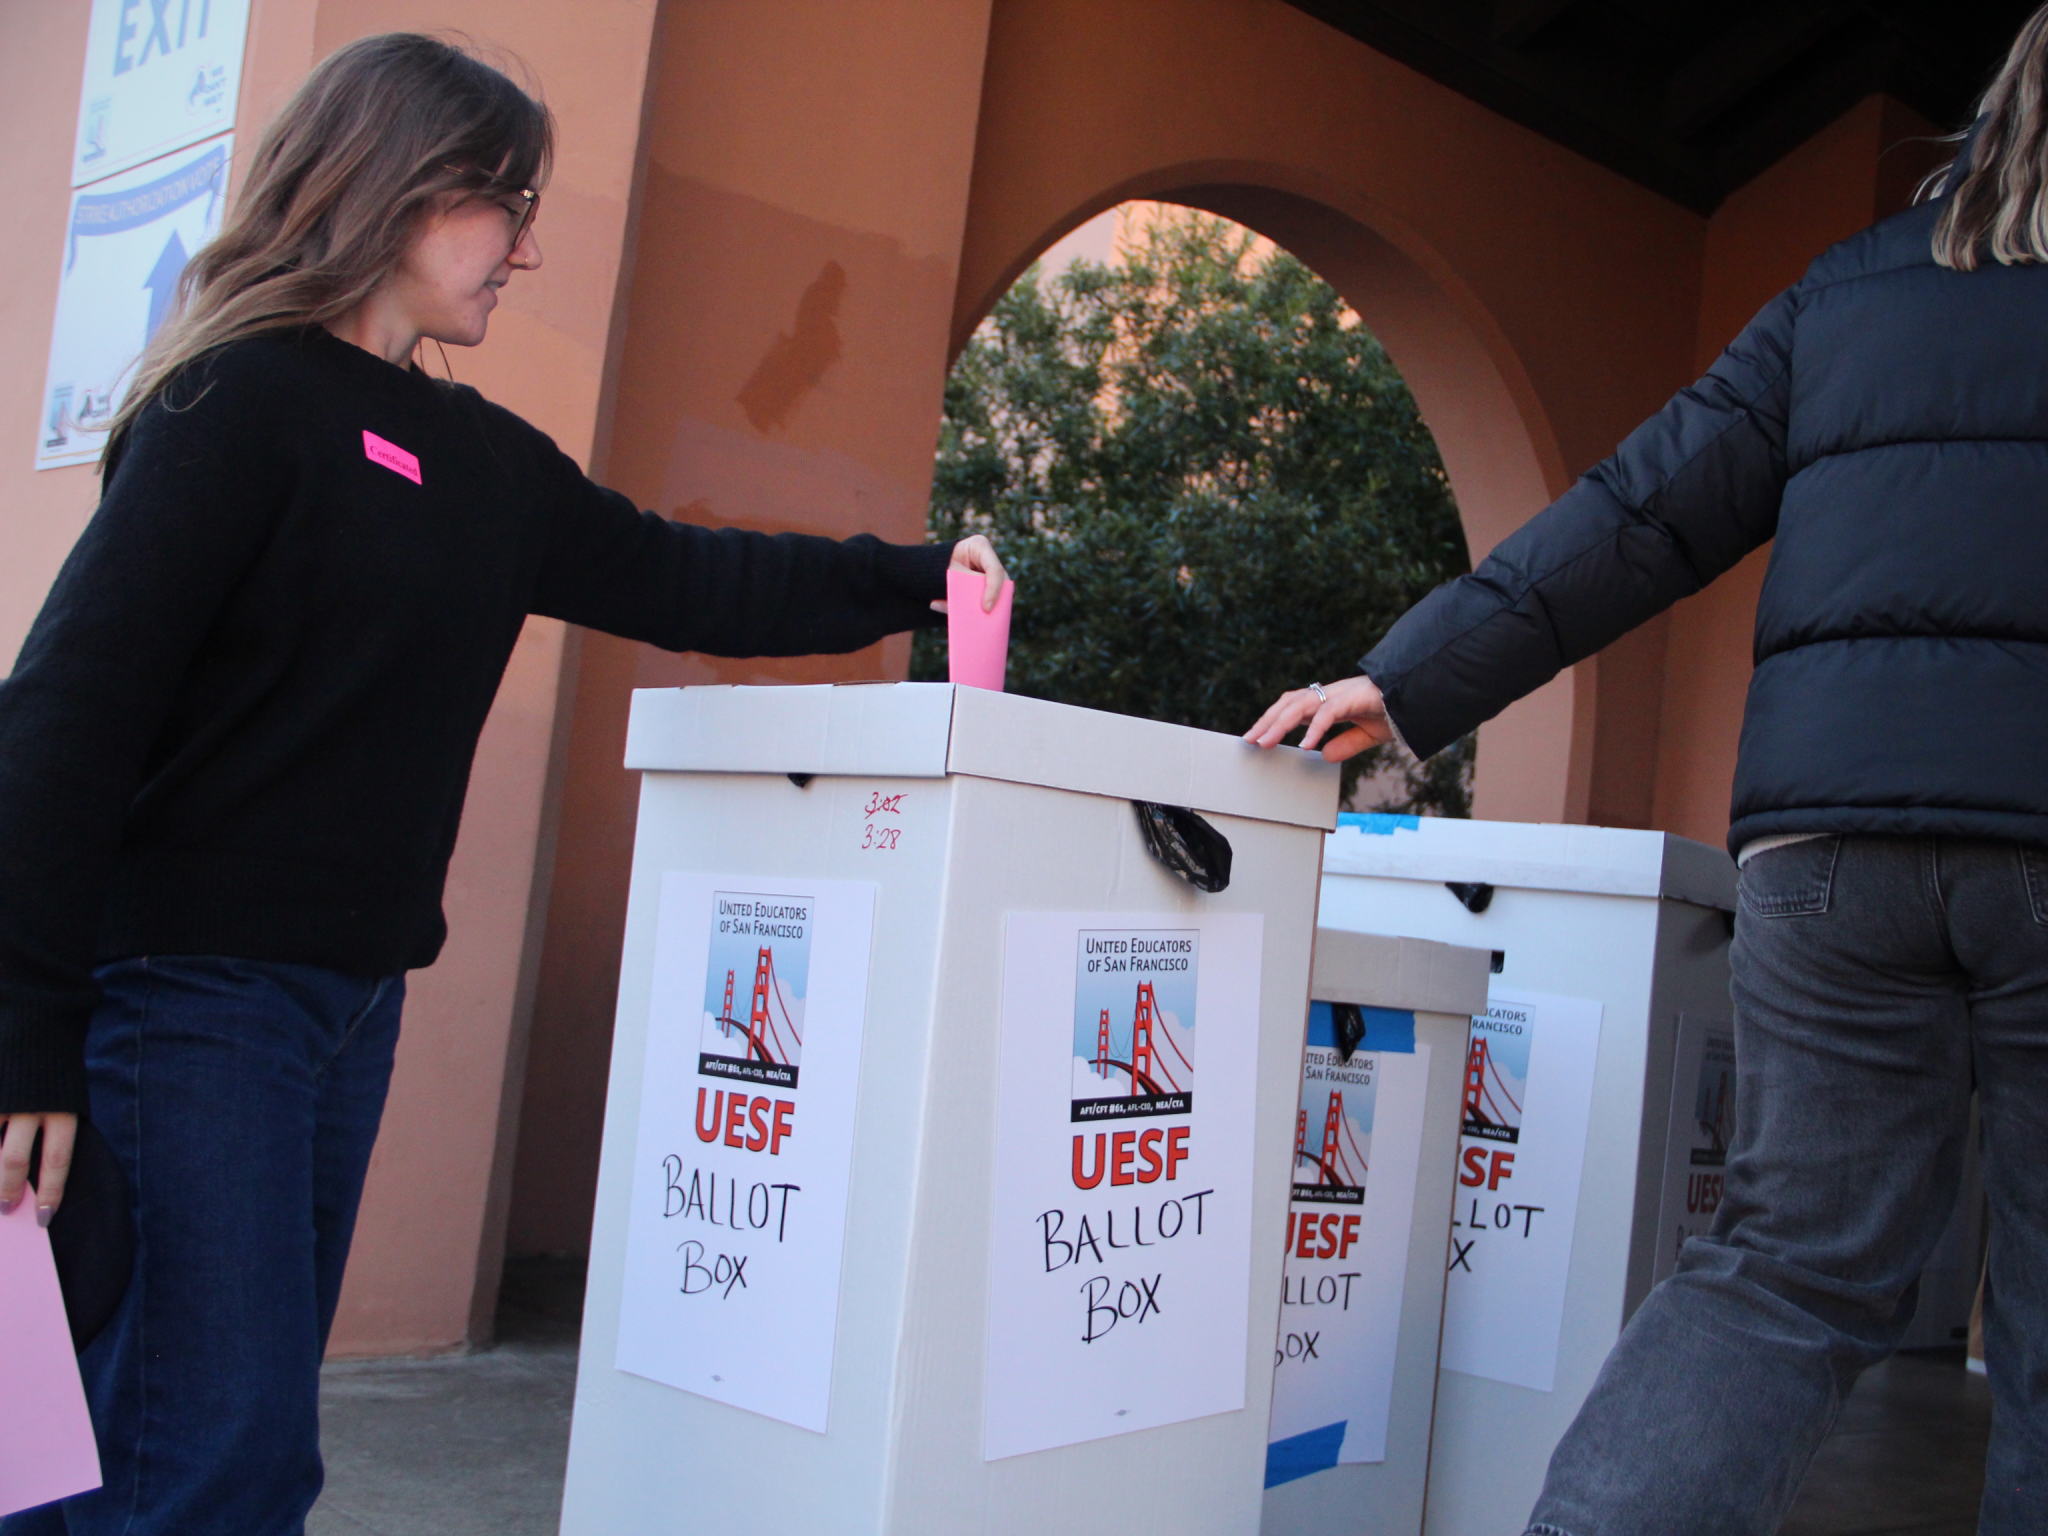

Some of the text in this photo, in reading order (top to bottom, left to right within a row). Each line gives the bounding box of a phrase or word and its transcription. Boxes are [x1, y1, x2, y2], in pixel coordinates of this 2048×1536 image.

[862, 824, 901, 849] 3:28
[719, 899, 807, 921] UNITED EDUCATORS
[719, 918, 804, 939] OF SAN FRANCISCO
[1086, 937, 1192, 954] UNITED EDUCATORS
[1087, 956, 1189, 973] OF SAN FRANCISCO
[1485, 1007, 1527, 1022] CATORS
[1472, 1019, 1523, 1035] RANCISCO
[705, 1059, 727, 1072] AFT/CFT
[765, 1068, 792, 1082] NEA/CTA
[1305, 1052, 1324, 1065] ITED
[1305, 1065, 1370, 1085] SAN FRANCISCO
[1080, 1102, 1108, 1116] AFT/CFT
[1109, 1103, 1127, 1114] #61,
[1155, 1097, 1184, 1110] NEA/CTA
[695, 1087, 795, 1155] UESF
[1071, 1126, 1191, 1190] UESF
[1460, 1145, 1515, 1191] SF
[662, 1154, 801, 1242] BALLOT
[1453, 1198, 1545, 1238] LOT
[1036, 1189, 1214, 1272] BALLOT
[676, 1240, 748, 1300] BOX
[1284, 1272, 1362, 1311] LLOT
[1080, 1275, 1162, 1344] BOX
